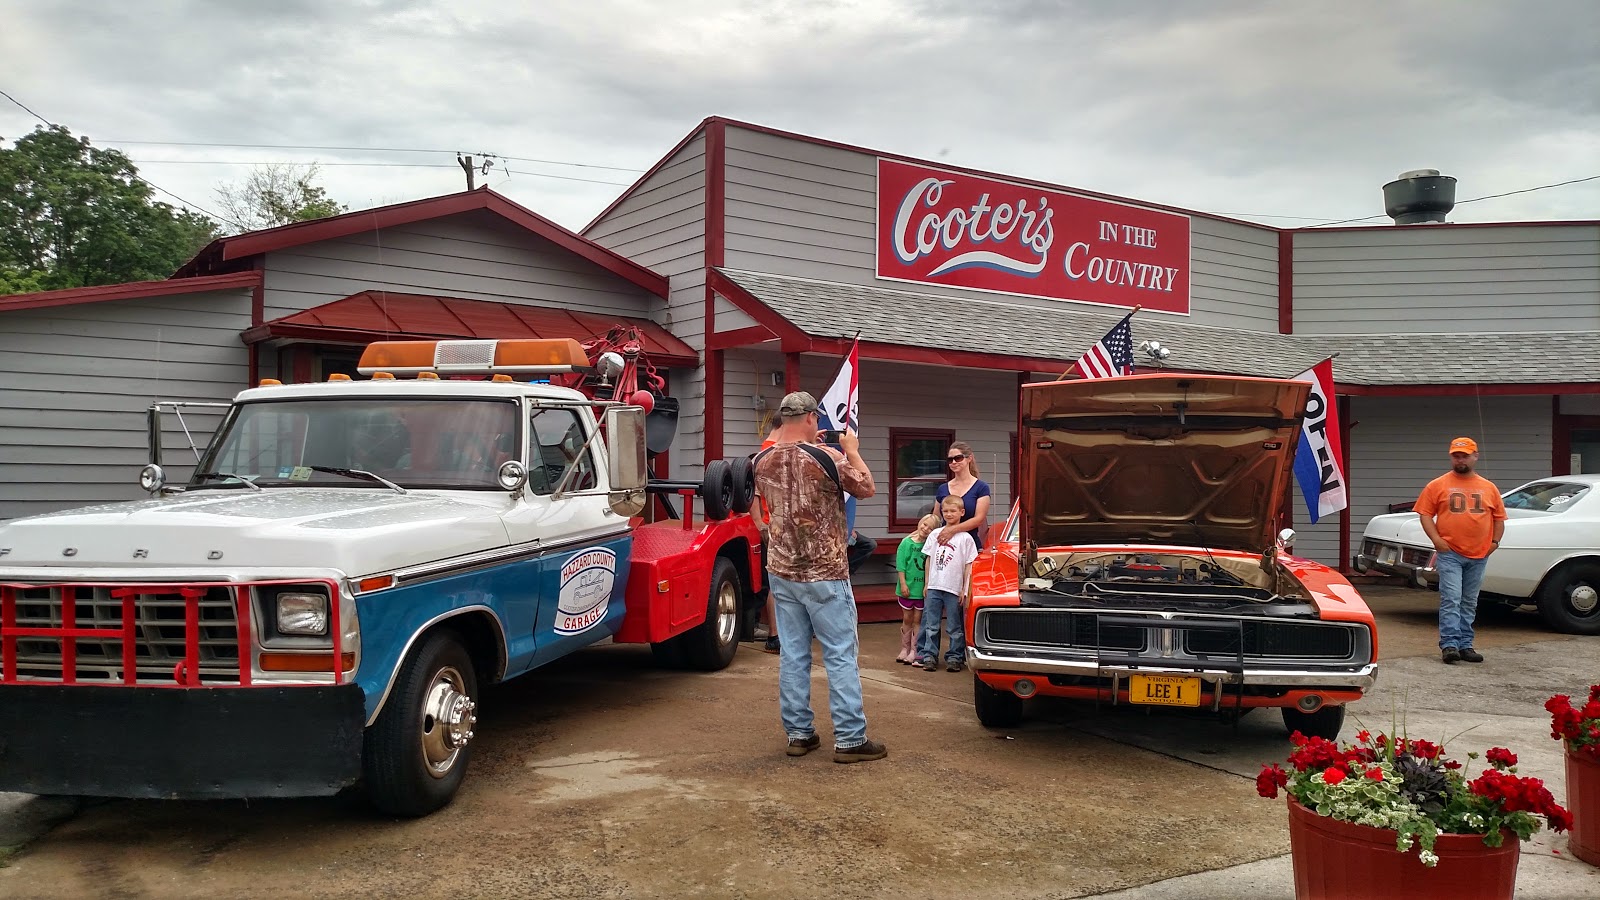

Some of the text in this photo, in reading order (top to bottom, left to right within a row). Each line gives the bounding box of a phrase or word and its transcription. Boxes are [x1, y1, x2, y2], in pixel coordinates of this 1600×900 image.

[892, 177, 1054, 276] Cooter's
[1098, 220, 1158, 249] IN THE
[1064, 241, 1179, 293] COUNTRY
[1448, 491, 1486, 514] 01
[0, 547, 224, 561] FORD
[563, 553, 614, 581] HAZZARD COUNTY
[564, 606, 600, 629] GARAGE
[1147, 684, 1171, 698] LEE
